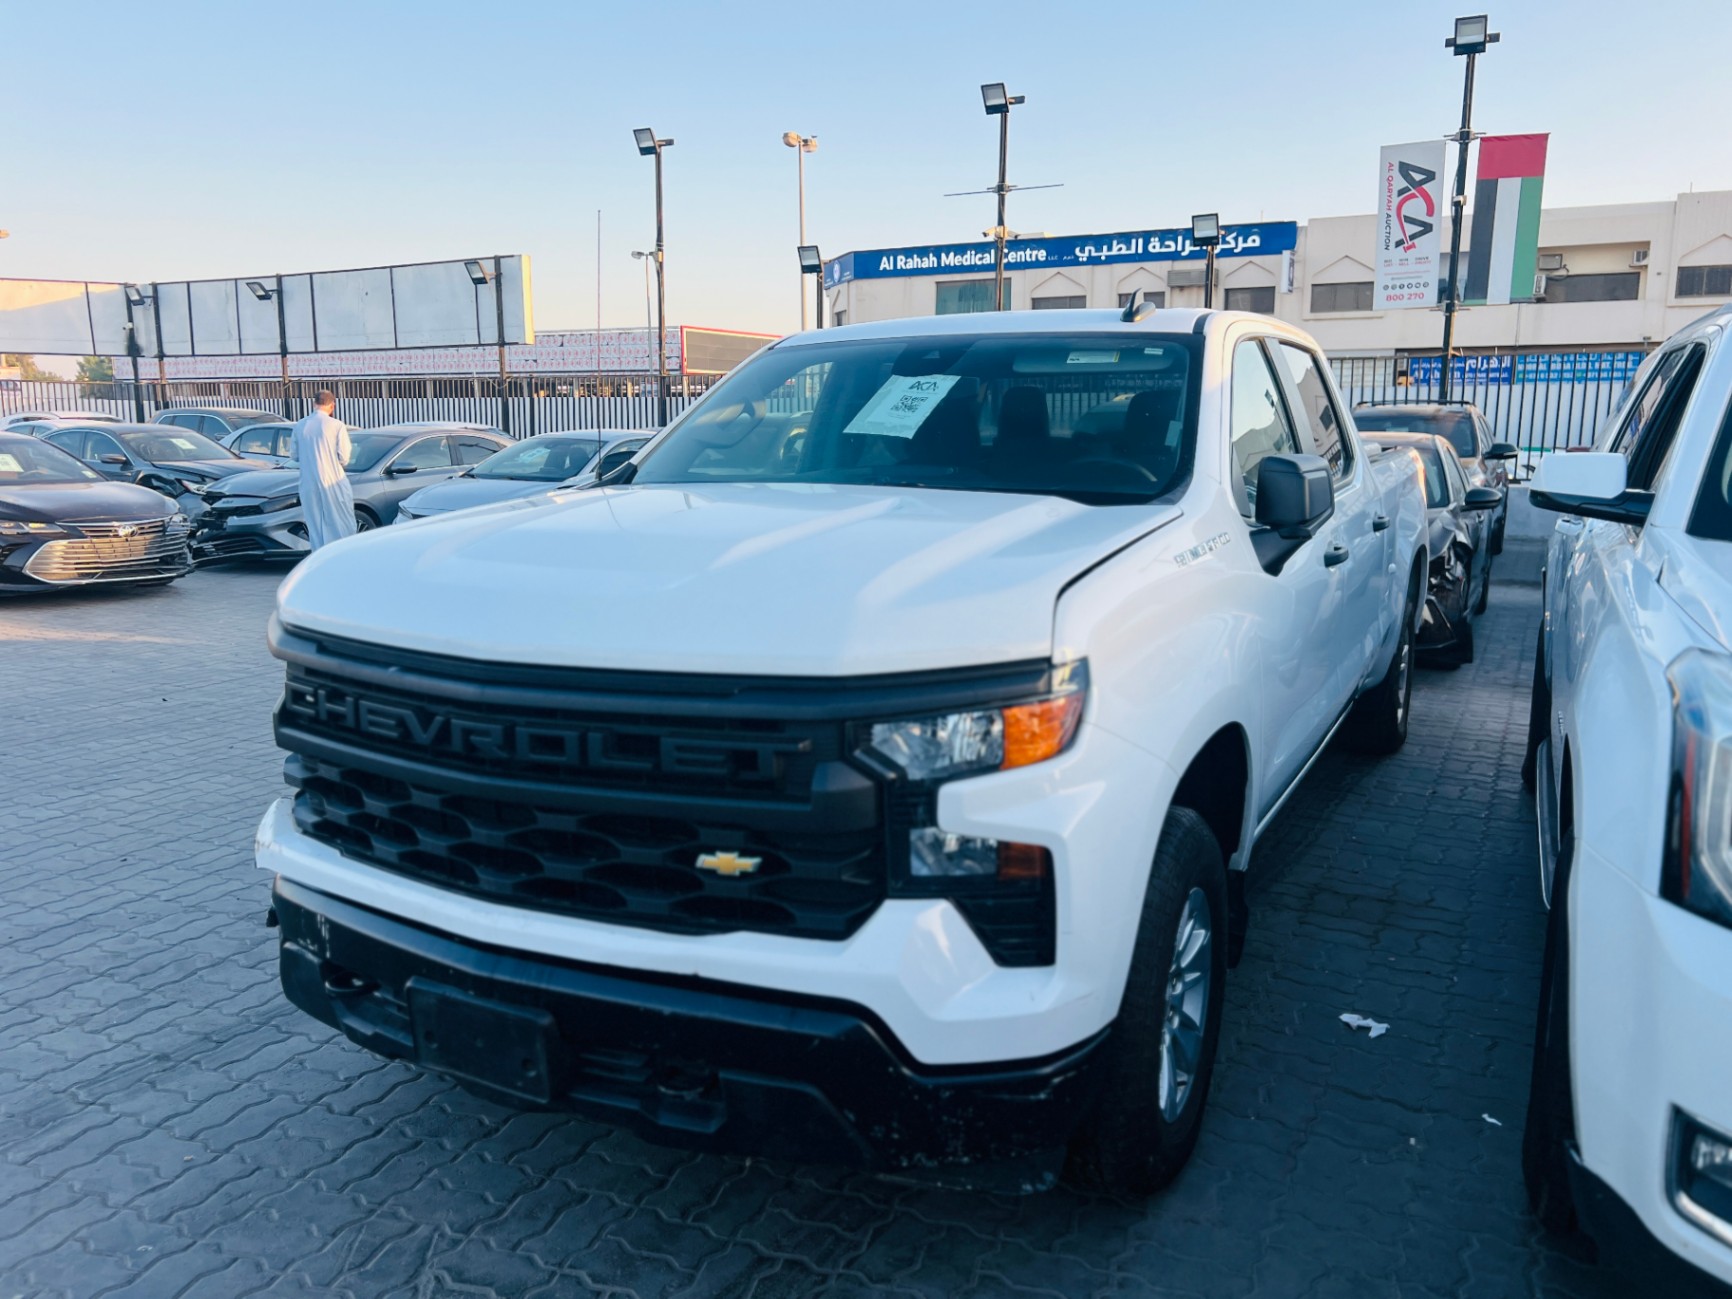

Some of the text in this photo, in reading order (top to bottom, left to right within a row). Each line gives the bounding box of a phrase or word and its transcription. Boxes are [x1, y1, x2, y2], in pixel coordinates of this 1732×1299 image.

[1384, 162, 1395, 251] AL QARYAH AUCTION
[1074, 237, 1144, 261] الطبي
[1147, 235, 1208, 257] راحة
[879, 255, 894, 271] Al
[896, 252, 938, 270] Rahah
[940, 248, 995, 268] Medical
[1386, 292, 1425, 302] 800 270
[285, 680, 812, 781] CHEVROLET
